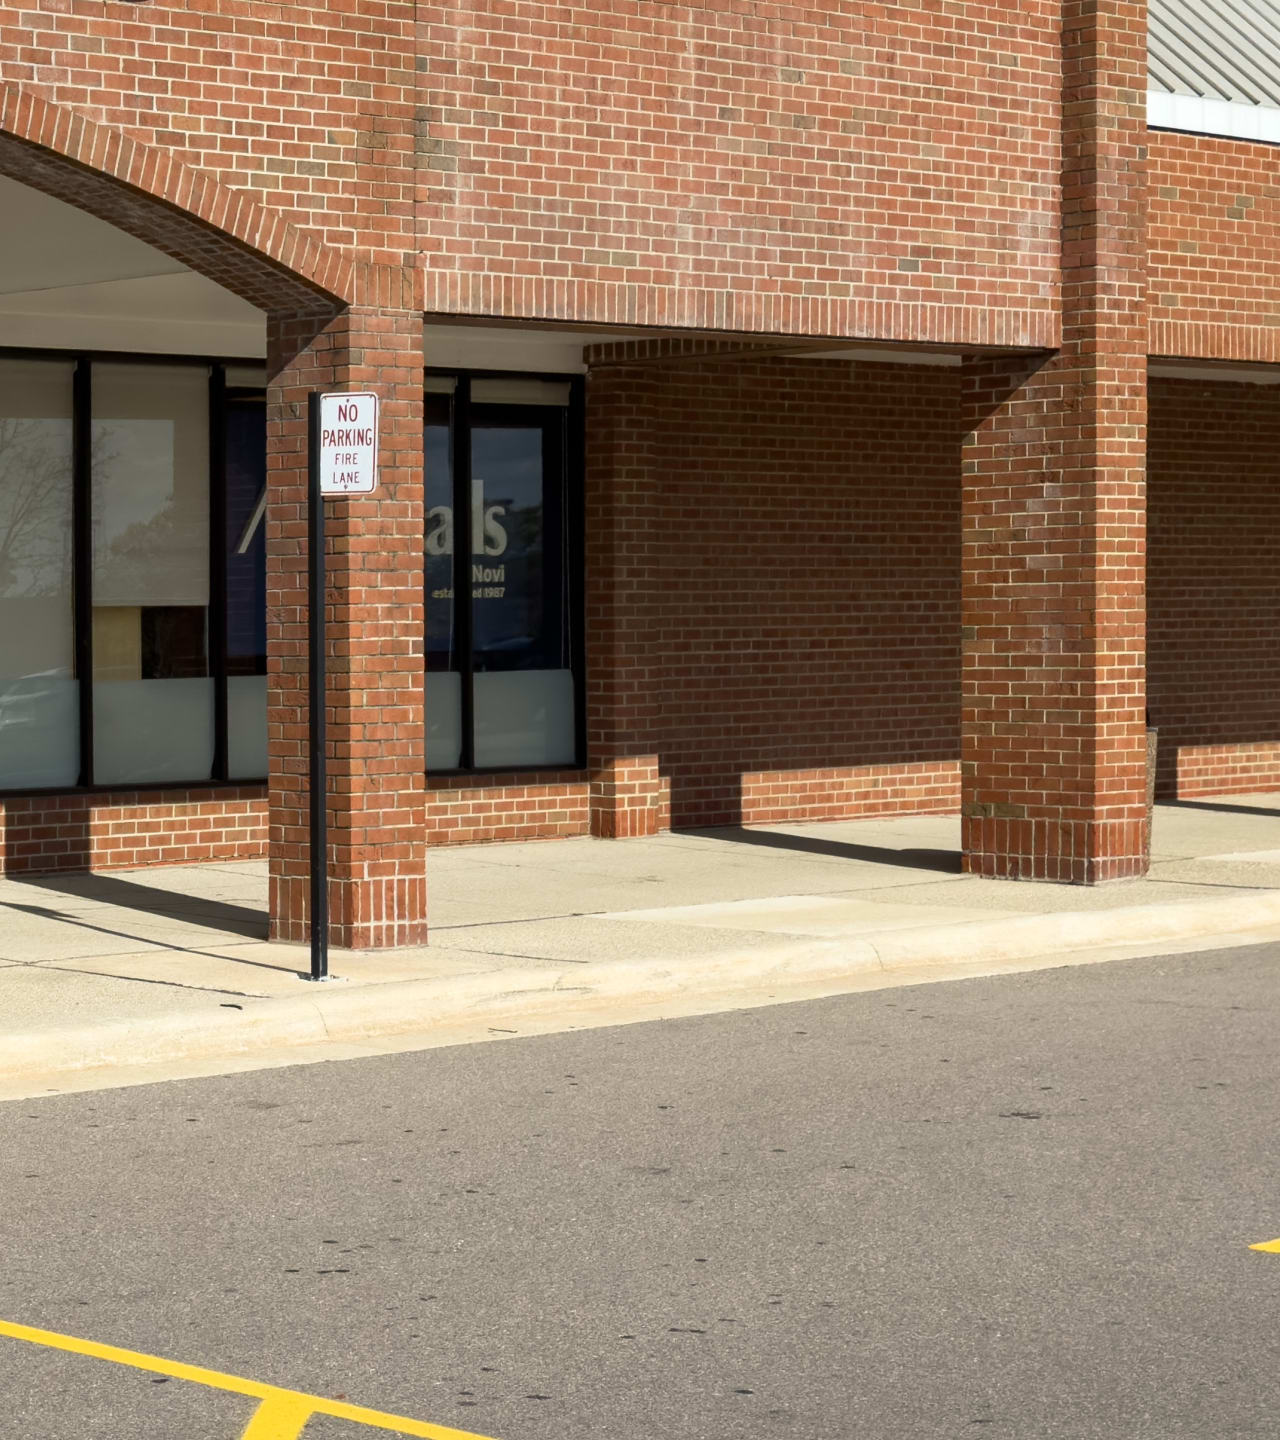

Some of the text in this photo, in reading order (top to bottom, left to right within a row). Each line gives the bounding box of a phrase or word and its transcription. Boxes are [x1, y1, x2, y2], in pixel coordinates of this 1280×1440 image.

[338, 404, 358, 422] NO
[322, 428, 372, 447] PARKING
[335, 453, 358, 465] FIRE
[333, 472, 360, 484] LANE
[471, 564, 505, 583] Novi
